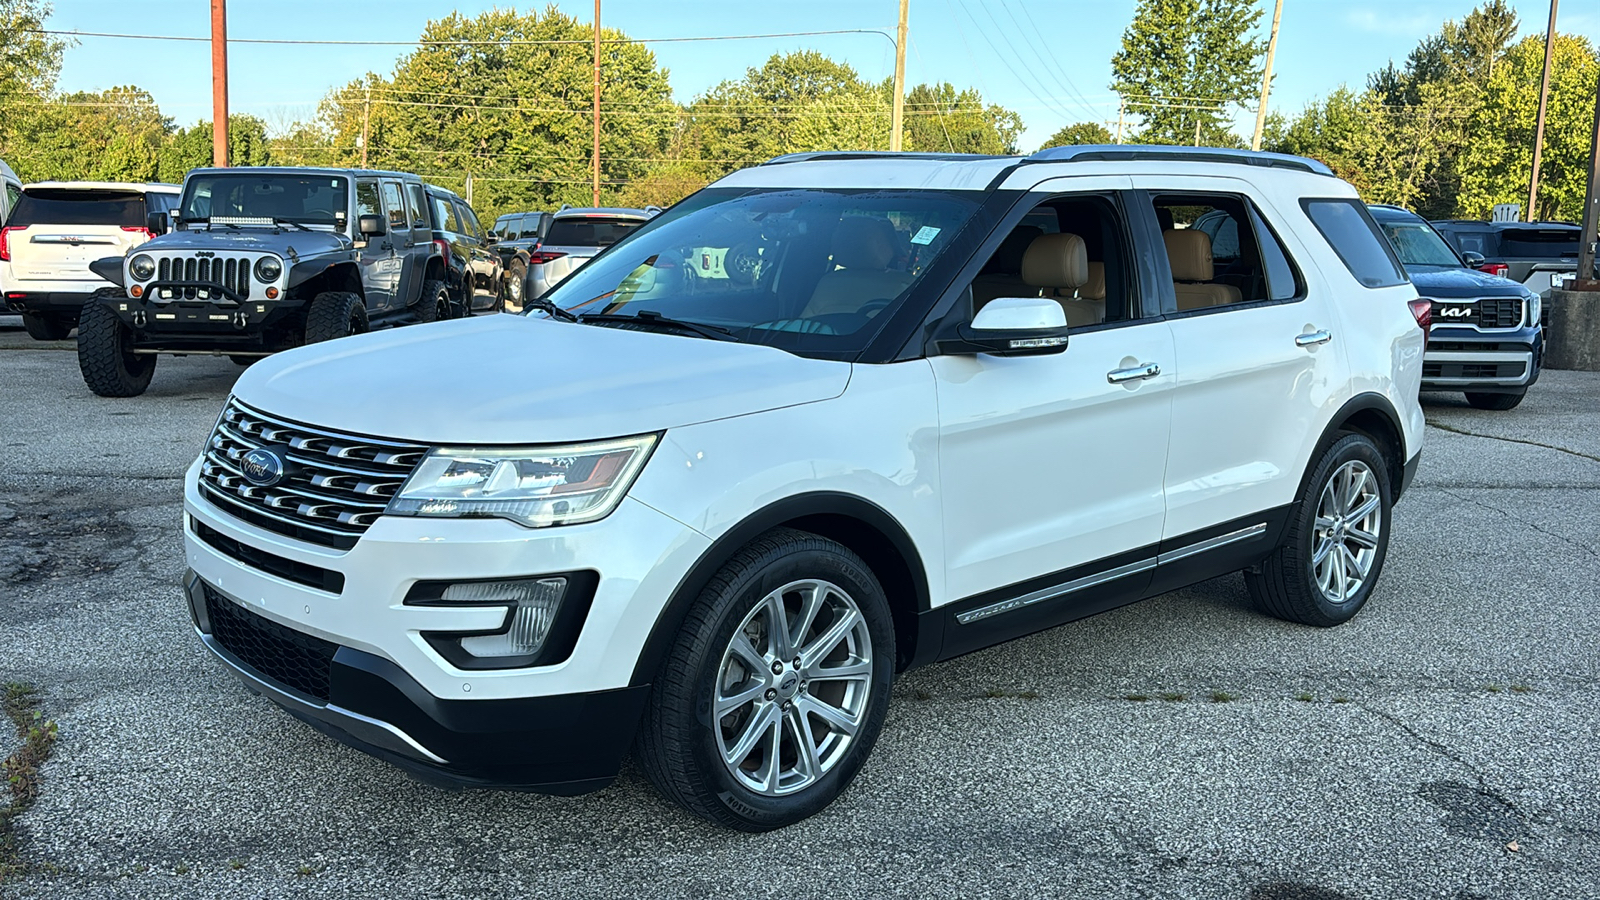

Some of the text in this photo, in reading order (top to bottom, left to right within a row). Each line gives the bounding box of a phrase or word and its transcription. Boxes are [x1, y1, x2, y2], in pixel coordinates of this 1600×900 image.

[195, 250, 215, 258] Jeep
[1440, 307, 1471, 317] KIA
[244, 454, 269, 477] Ford
